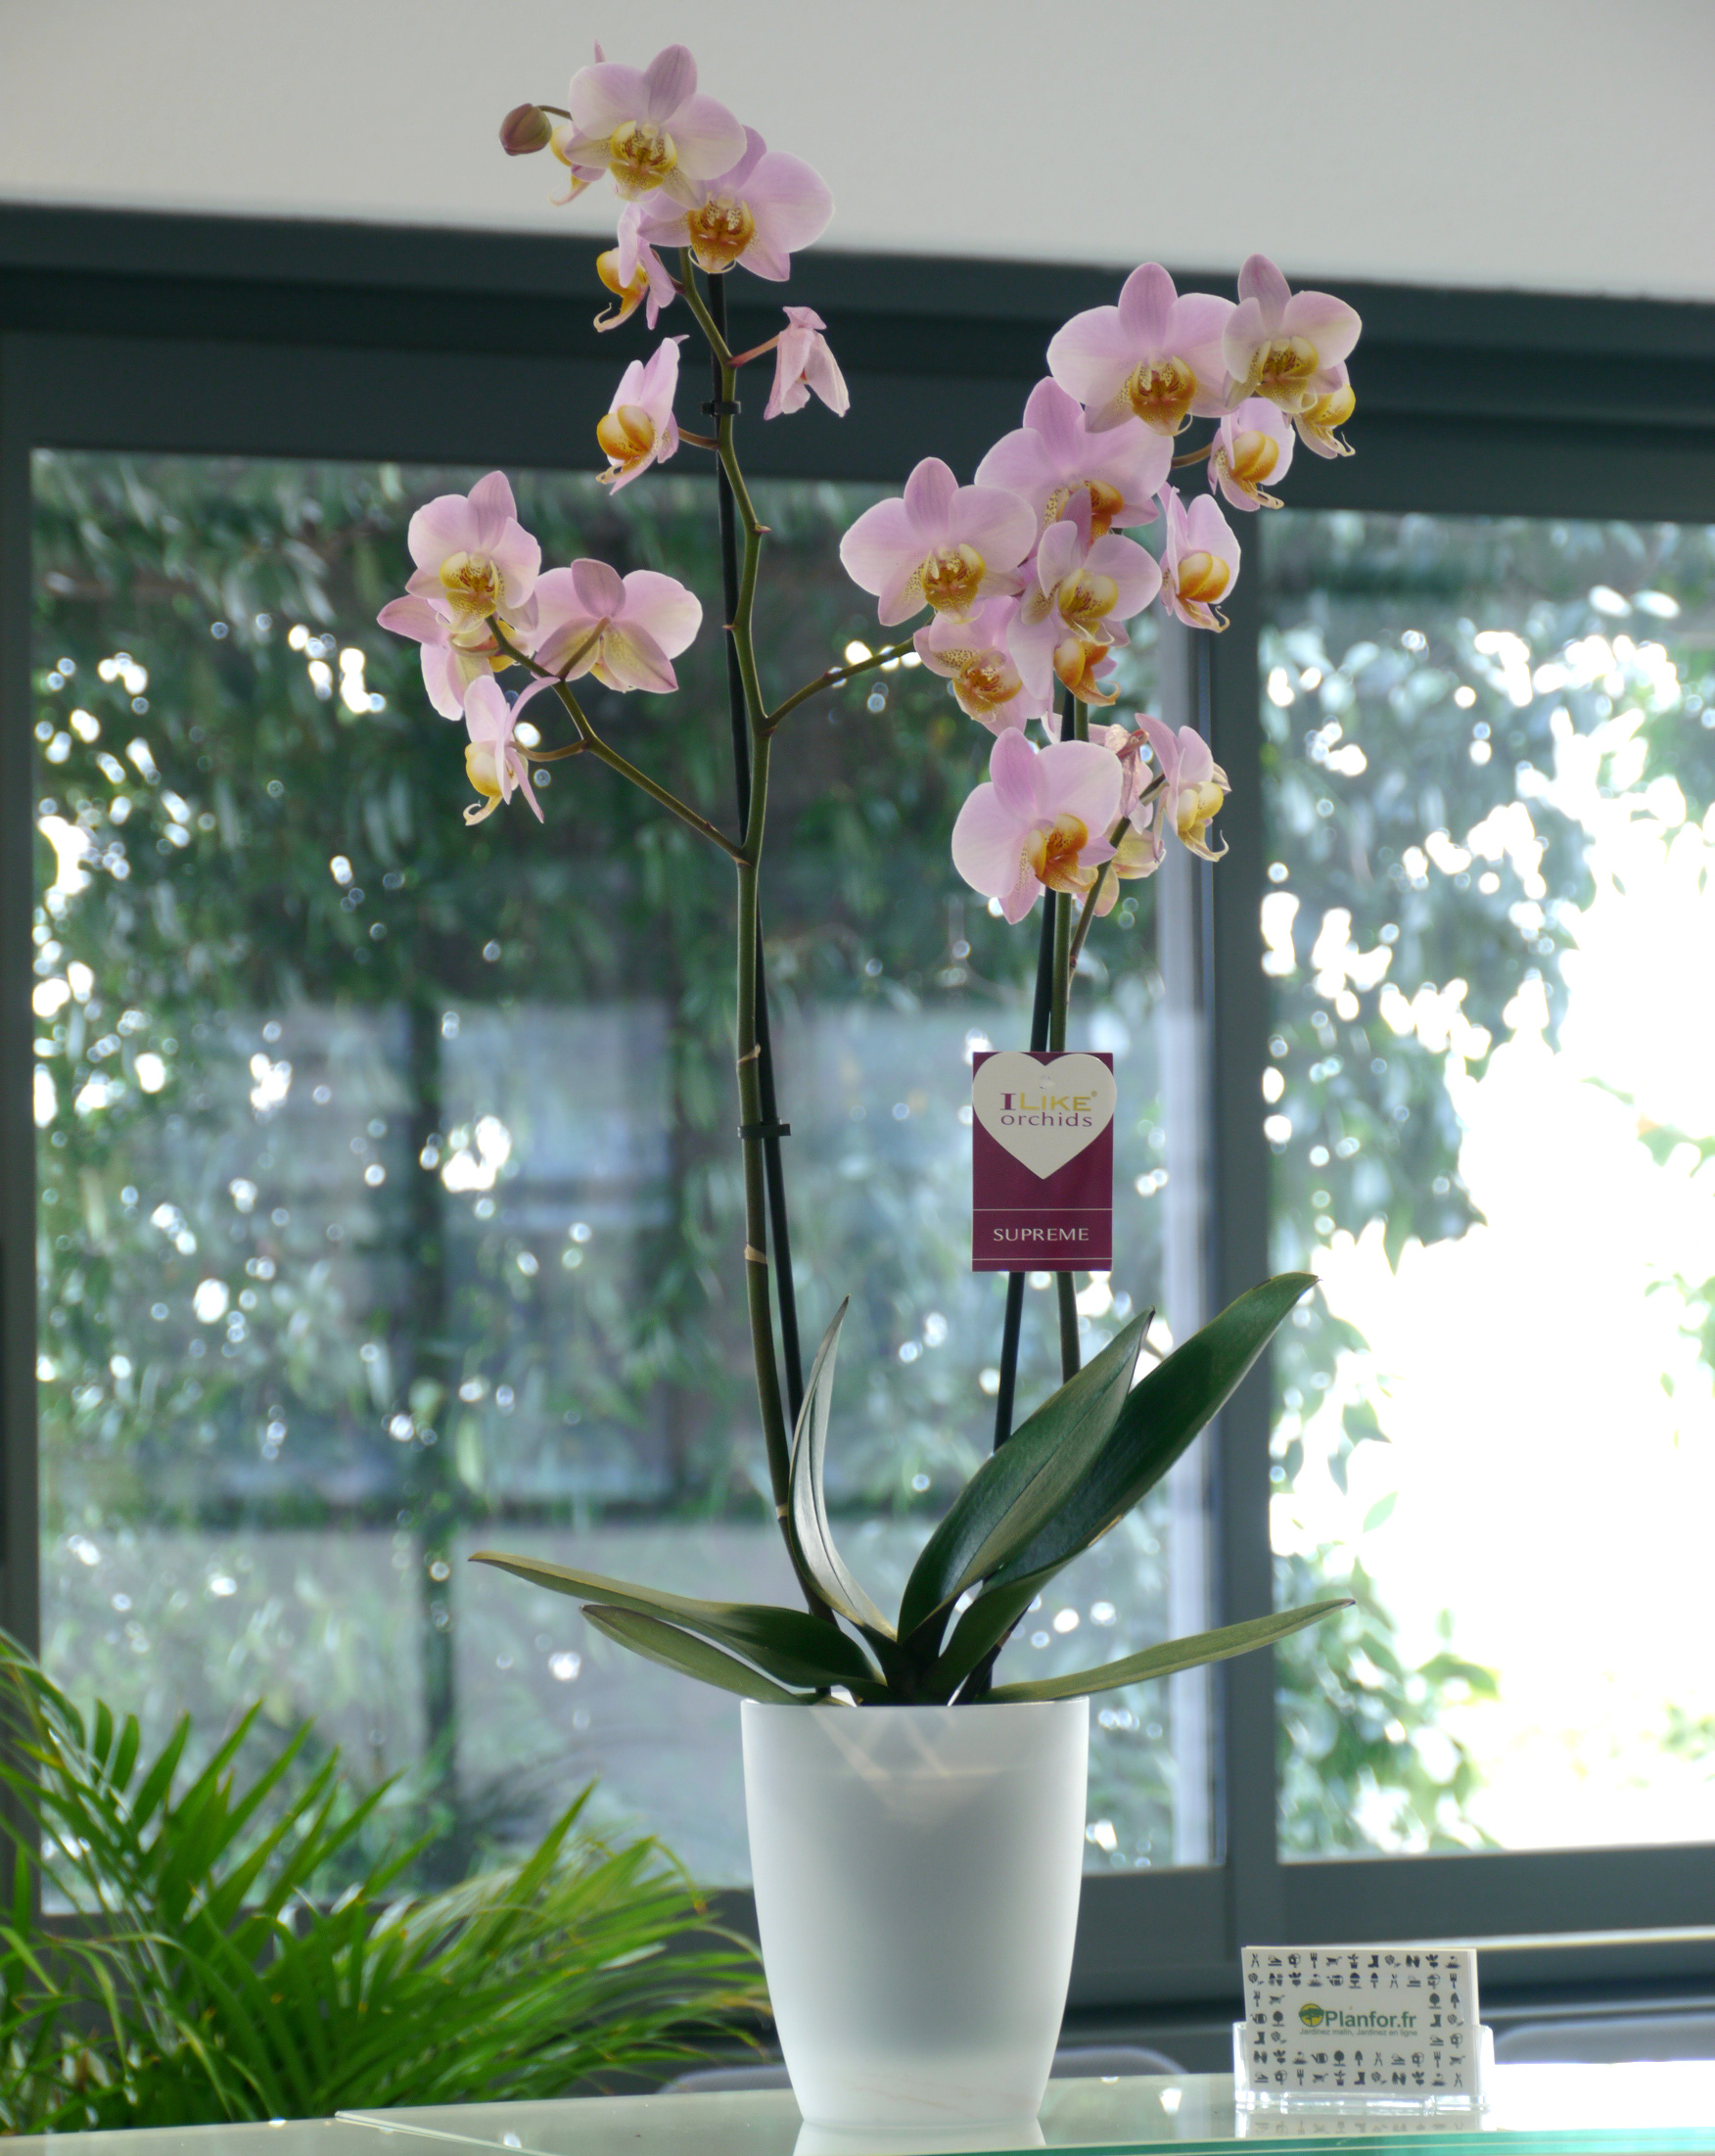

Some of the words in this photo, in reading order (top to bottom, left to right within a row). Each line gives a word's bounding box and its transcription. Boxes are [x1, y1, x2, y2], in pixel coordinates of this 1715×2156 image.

[1000, 1093, 1016, 1111] I
[1000, 1112, 1092, 1127] orchids
[993, 1228, 1089, 1242] SUPREME
[1325, 2010, 1417, 2028] Planfor.fr
[1332, 2028, 1354, 2037] malin,
[1400, 2029, 1418, 2039] ligne
